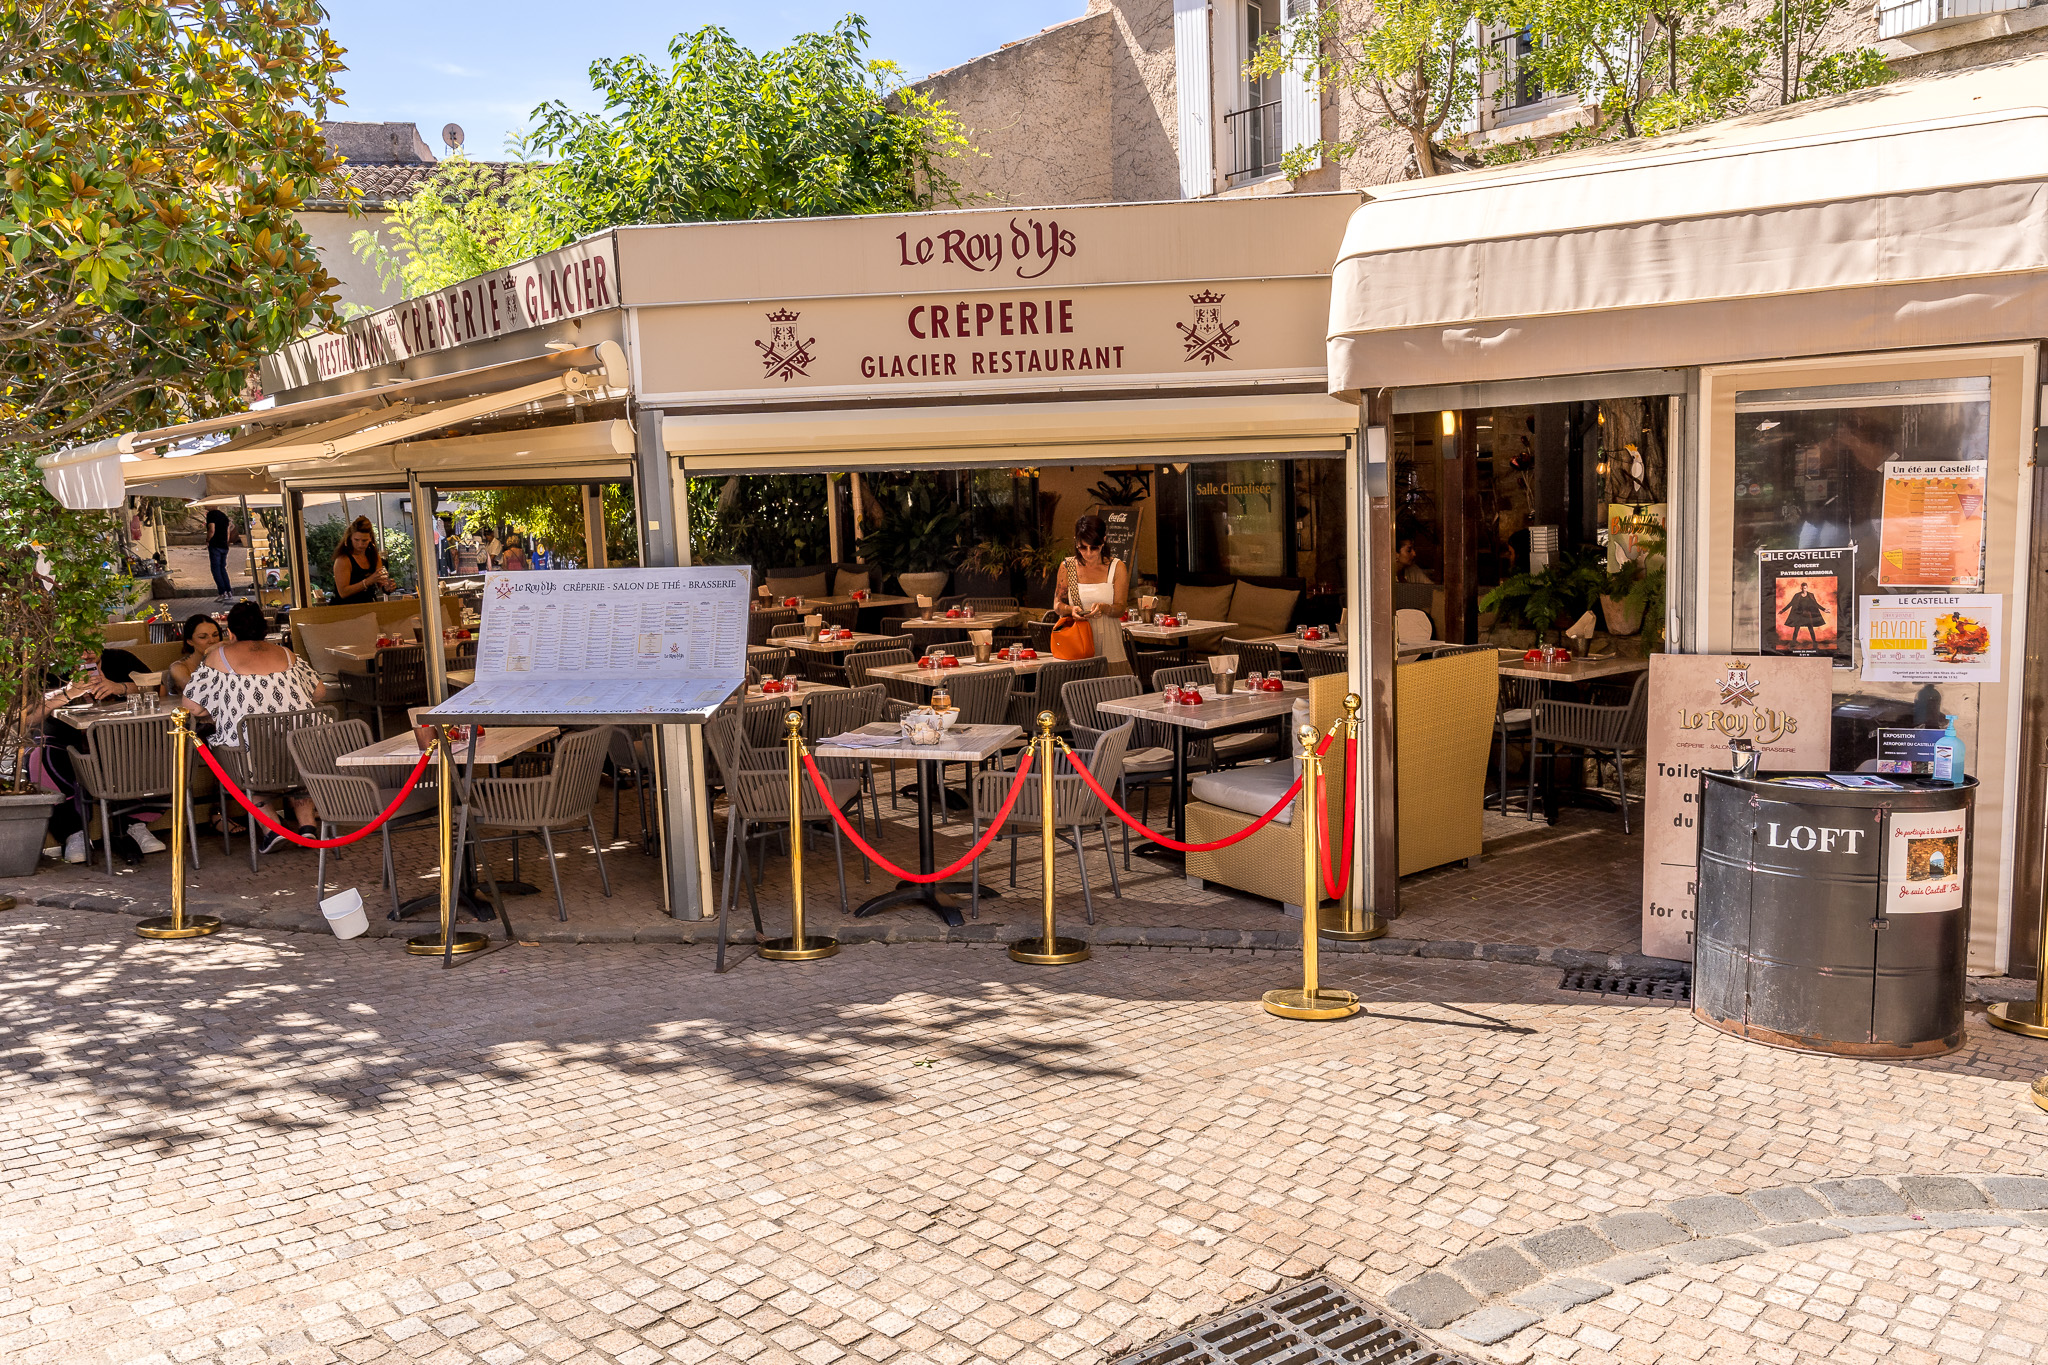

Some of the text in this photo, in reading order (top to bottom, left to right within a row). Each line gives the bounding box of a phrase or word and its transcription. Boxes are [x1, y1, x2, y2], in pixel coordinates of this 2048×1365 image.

[895, 231, 934, 266] Le
[937, 229, 1003, 272] Roy
[318, 255, 610, 377] RESTAURANT CRÊPERIE GLACIER
[907, 300, 1074, 339] CRÊPERIE
[860, 346, 1125, 379] GLACIER RESTAURANT
[1940, 465, 1980, 473] Castellet
[1196, 482, 1271, 495] Salle Climatisée
[1772, 551, 1842, 561] LE CASTELLET
[515, 583, 523, 591] Le
[563, 582, 605, 591] CRÊPERIE
[612, 582, 644, 590] SALON
[646, 582, 659, 590] DE
[662, 580, 680, 590] THÉ
[688, 580, 737, 589] BRASSERIE
[1911, 597, 1959, 605] CASTELLET
[1871, 620, 1927, 638] HAVANE
[1678, 708, 1703, 730] Le
[1705, 709, 1748, 738] Roy
[1673, 813, 1693, 828] du
[1767, 822, 1864, 855] LOFT
[1895, 828, 1903, 837] Je
[1903, 828, 1926, 838] participe
[1899, 886, 1909, 898] Je
[1650, 902, 1674, 917] for
